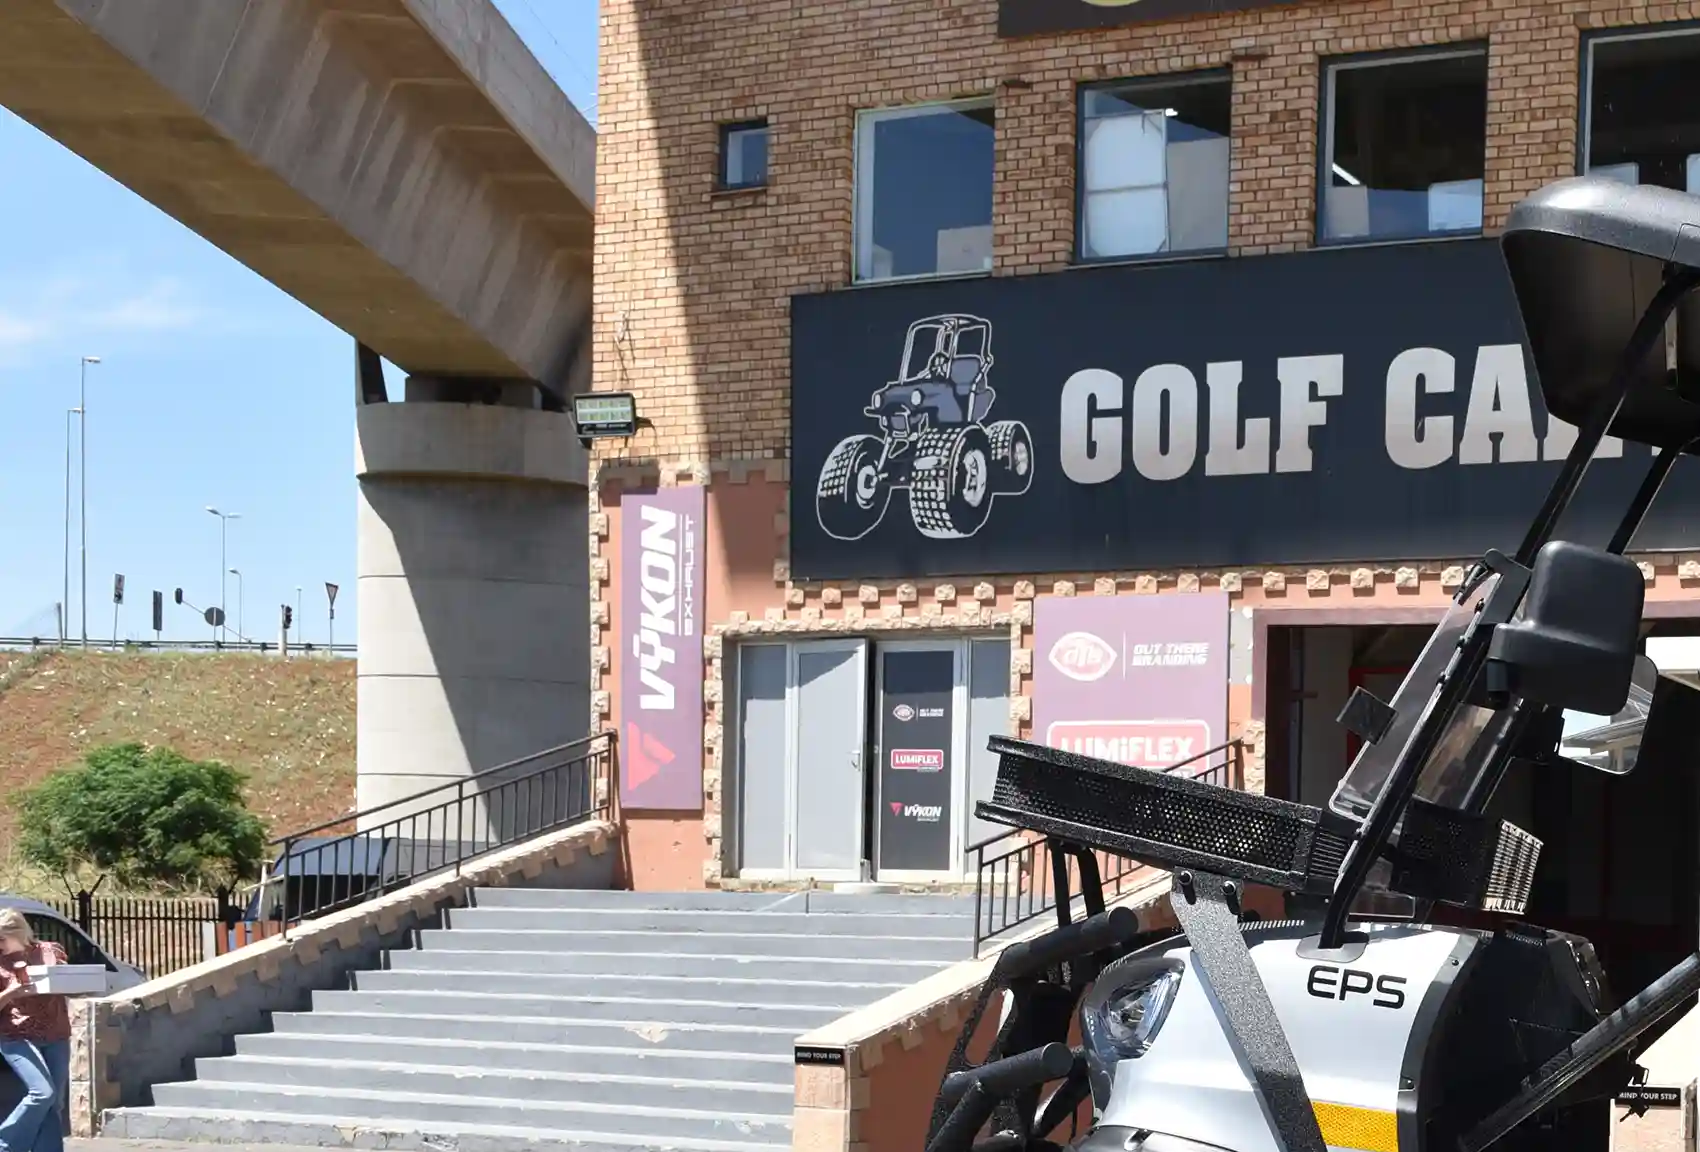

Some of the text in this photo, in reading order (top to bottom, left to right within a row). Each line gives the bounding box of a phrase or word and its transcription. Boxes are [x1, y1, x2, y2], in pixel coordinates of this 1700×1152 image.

[1060, 343, 1690, 485] GOLF CA
[1307, 965, 1407, 1010] EPS
